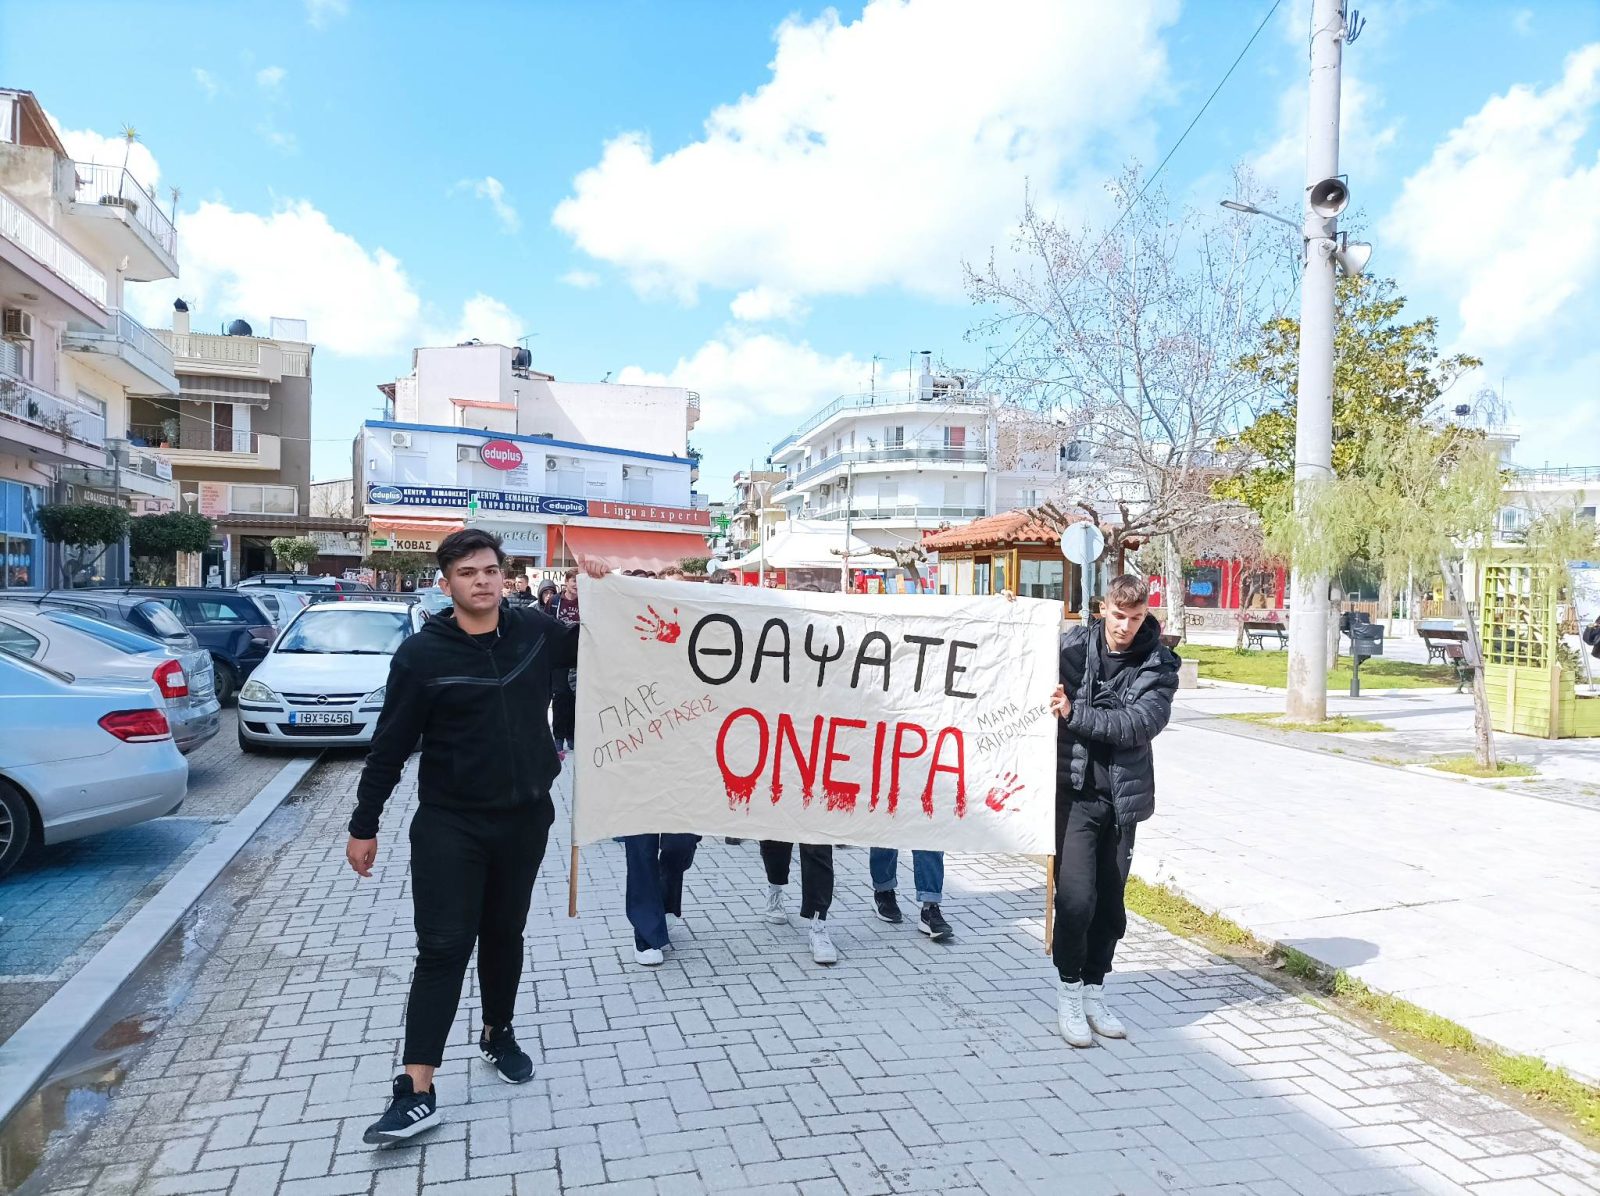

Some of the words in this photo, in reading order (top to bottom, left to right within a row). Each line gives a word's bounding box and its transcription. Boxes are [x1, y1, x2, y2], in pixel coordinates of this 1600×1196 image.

[484, 449, 521, 463] eduplus
[372, 491, 400, 500] eduplus
[404, 488, 427, 496] ΚΕΝΤΡΑ
[549, 502, 583, 511] eduplus
[688, 613, 978, 699] ΘΑΨΑΤΕ
[599, 681, 665, 734] ΠΑΡΕ
[977, 702, 1019, 731] ΜΑΜΑ
[593, 727, 644, 768] ΟΤΑΝ
[648, 694, 719, 740] ΦΤΑΣΕΙΣ
[716, 707, 967, 819] ΟΝΕΙΡΑ
